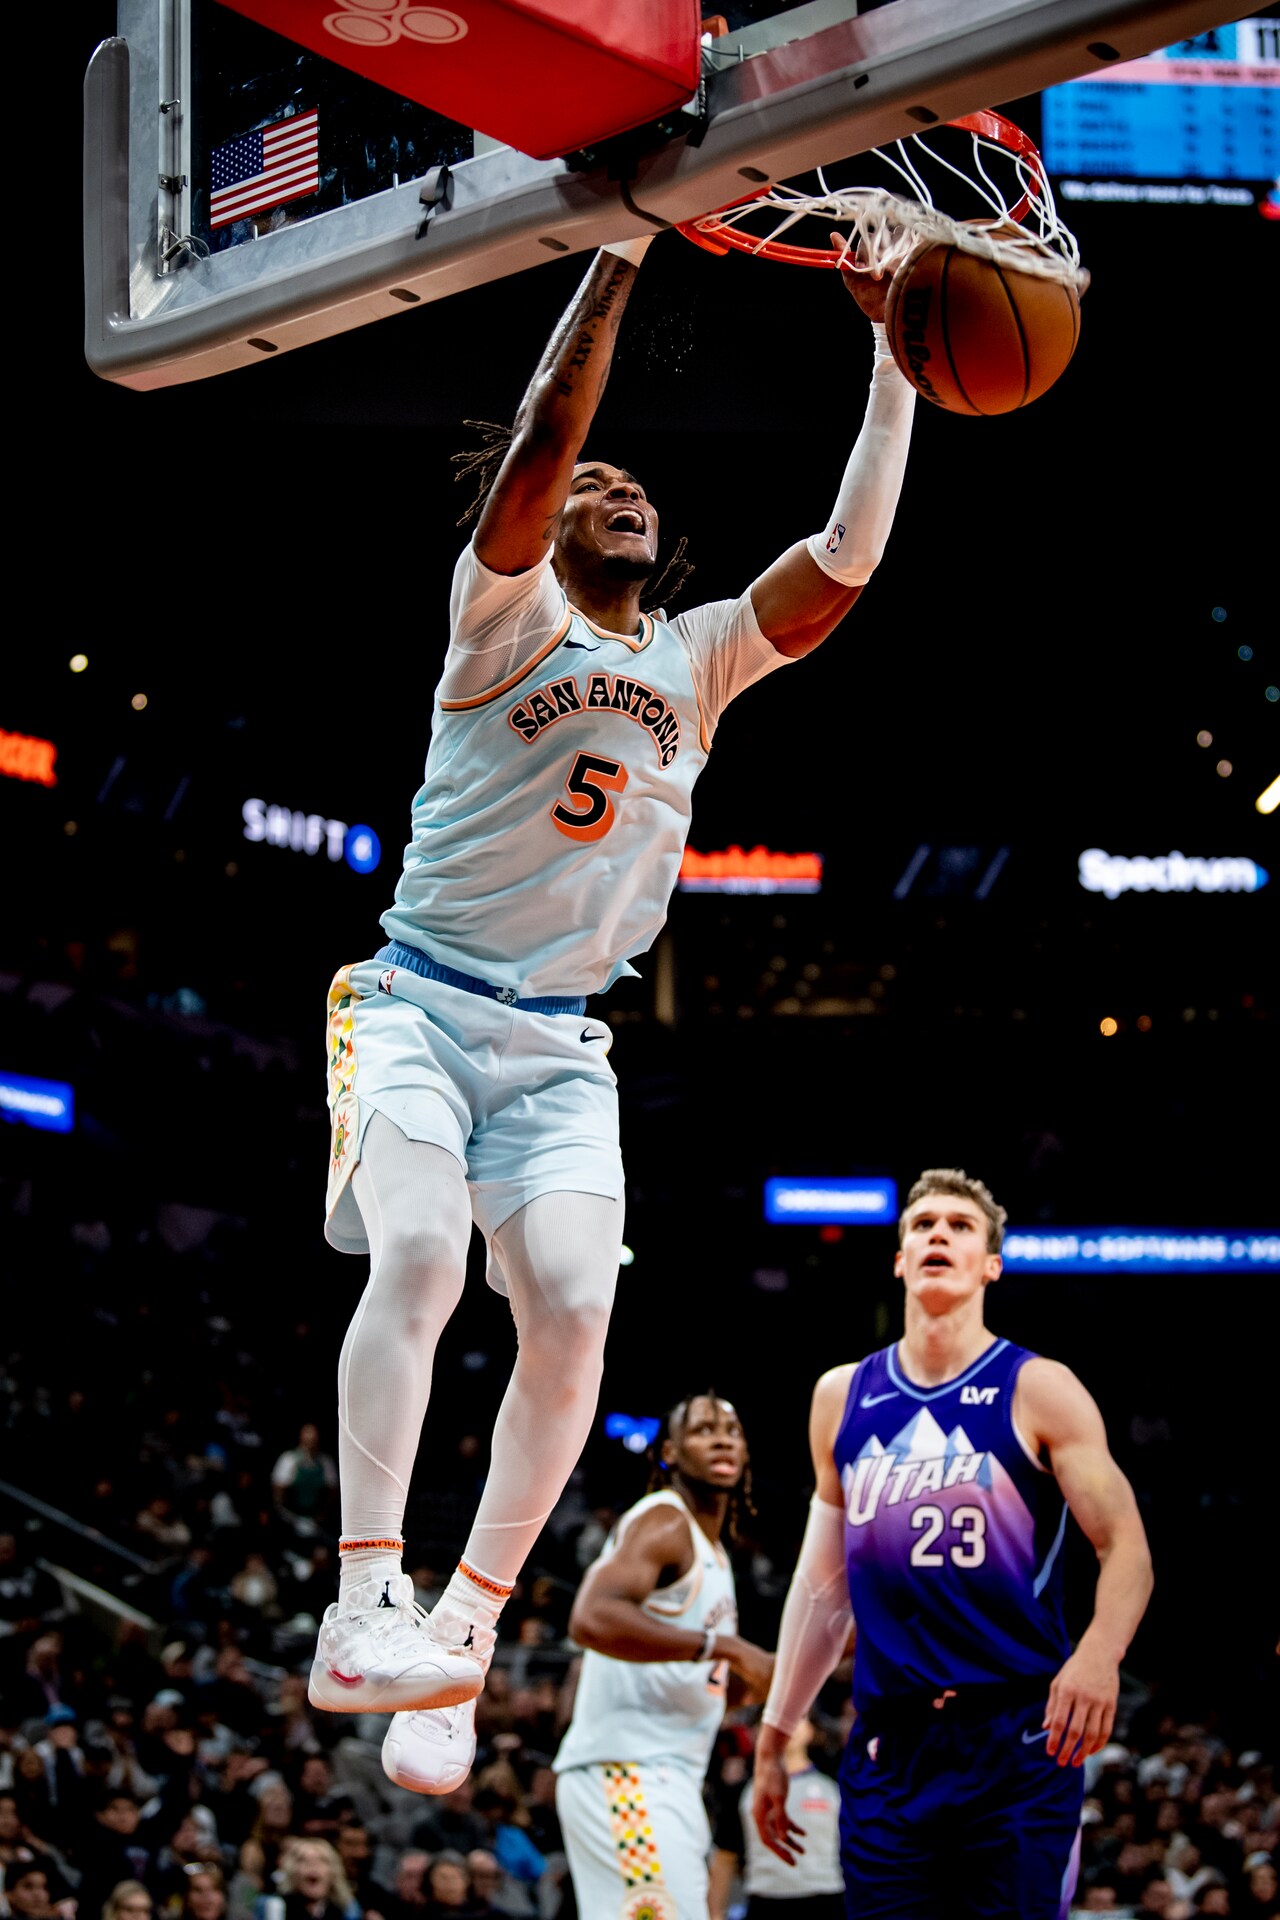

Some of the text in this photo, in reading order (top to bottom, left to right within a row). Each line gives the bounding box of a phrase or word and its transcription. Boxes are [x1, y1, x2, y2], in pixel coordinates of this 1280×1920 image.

[507, 673, 682, 770] SAN ANTONIO
[550, 750, 629, 842] 5
[1078, 847, 1257, 900] Spectrum
[959, 1385, 1000, 1405] LVT
[847, 1452, 986, 1527] UTAH
[910, 1504, 987, 1568] 23
